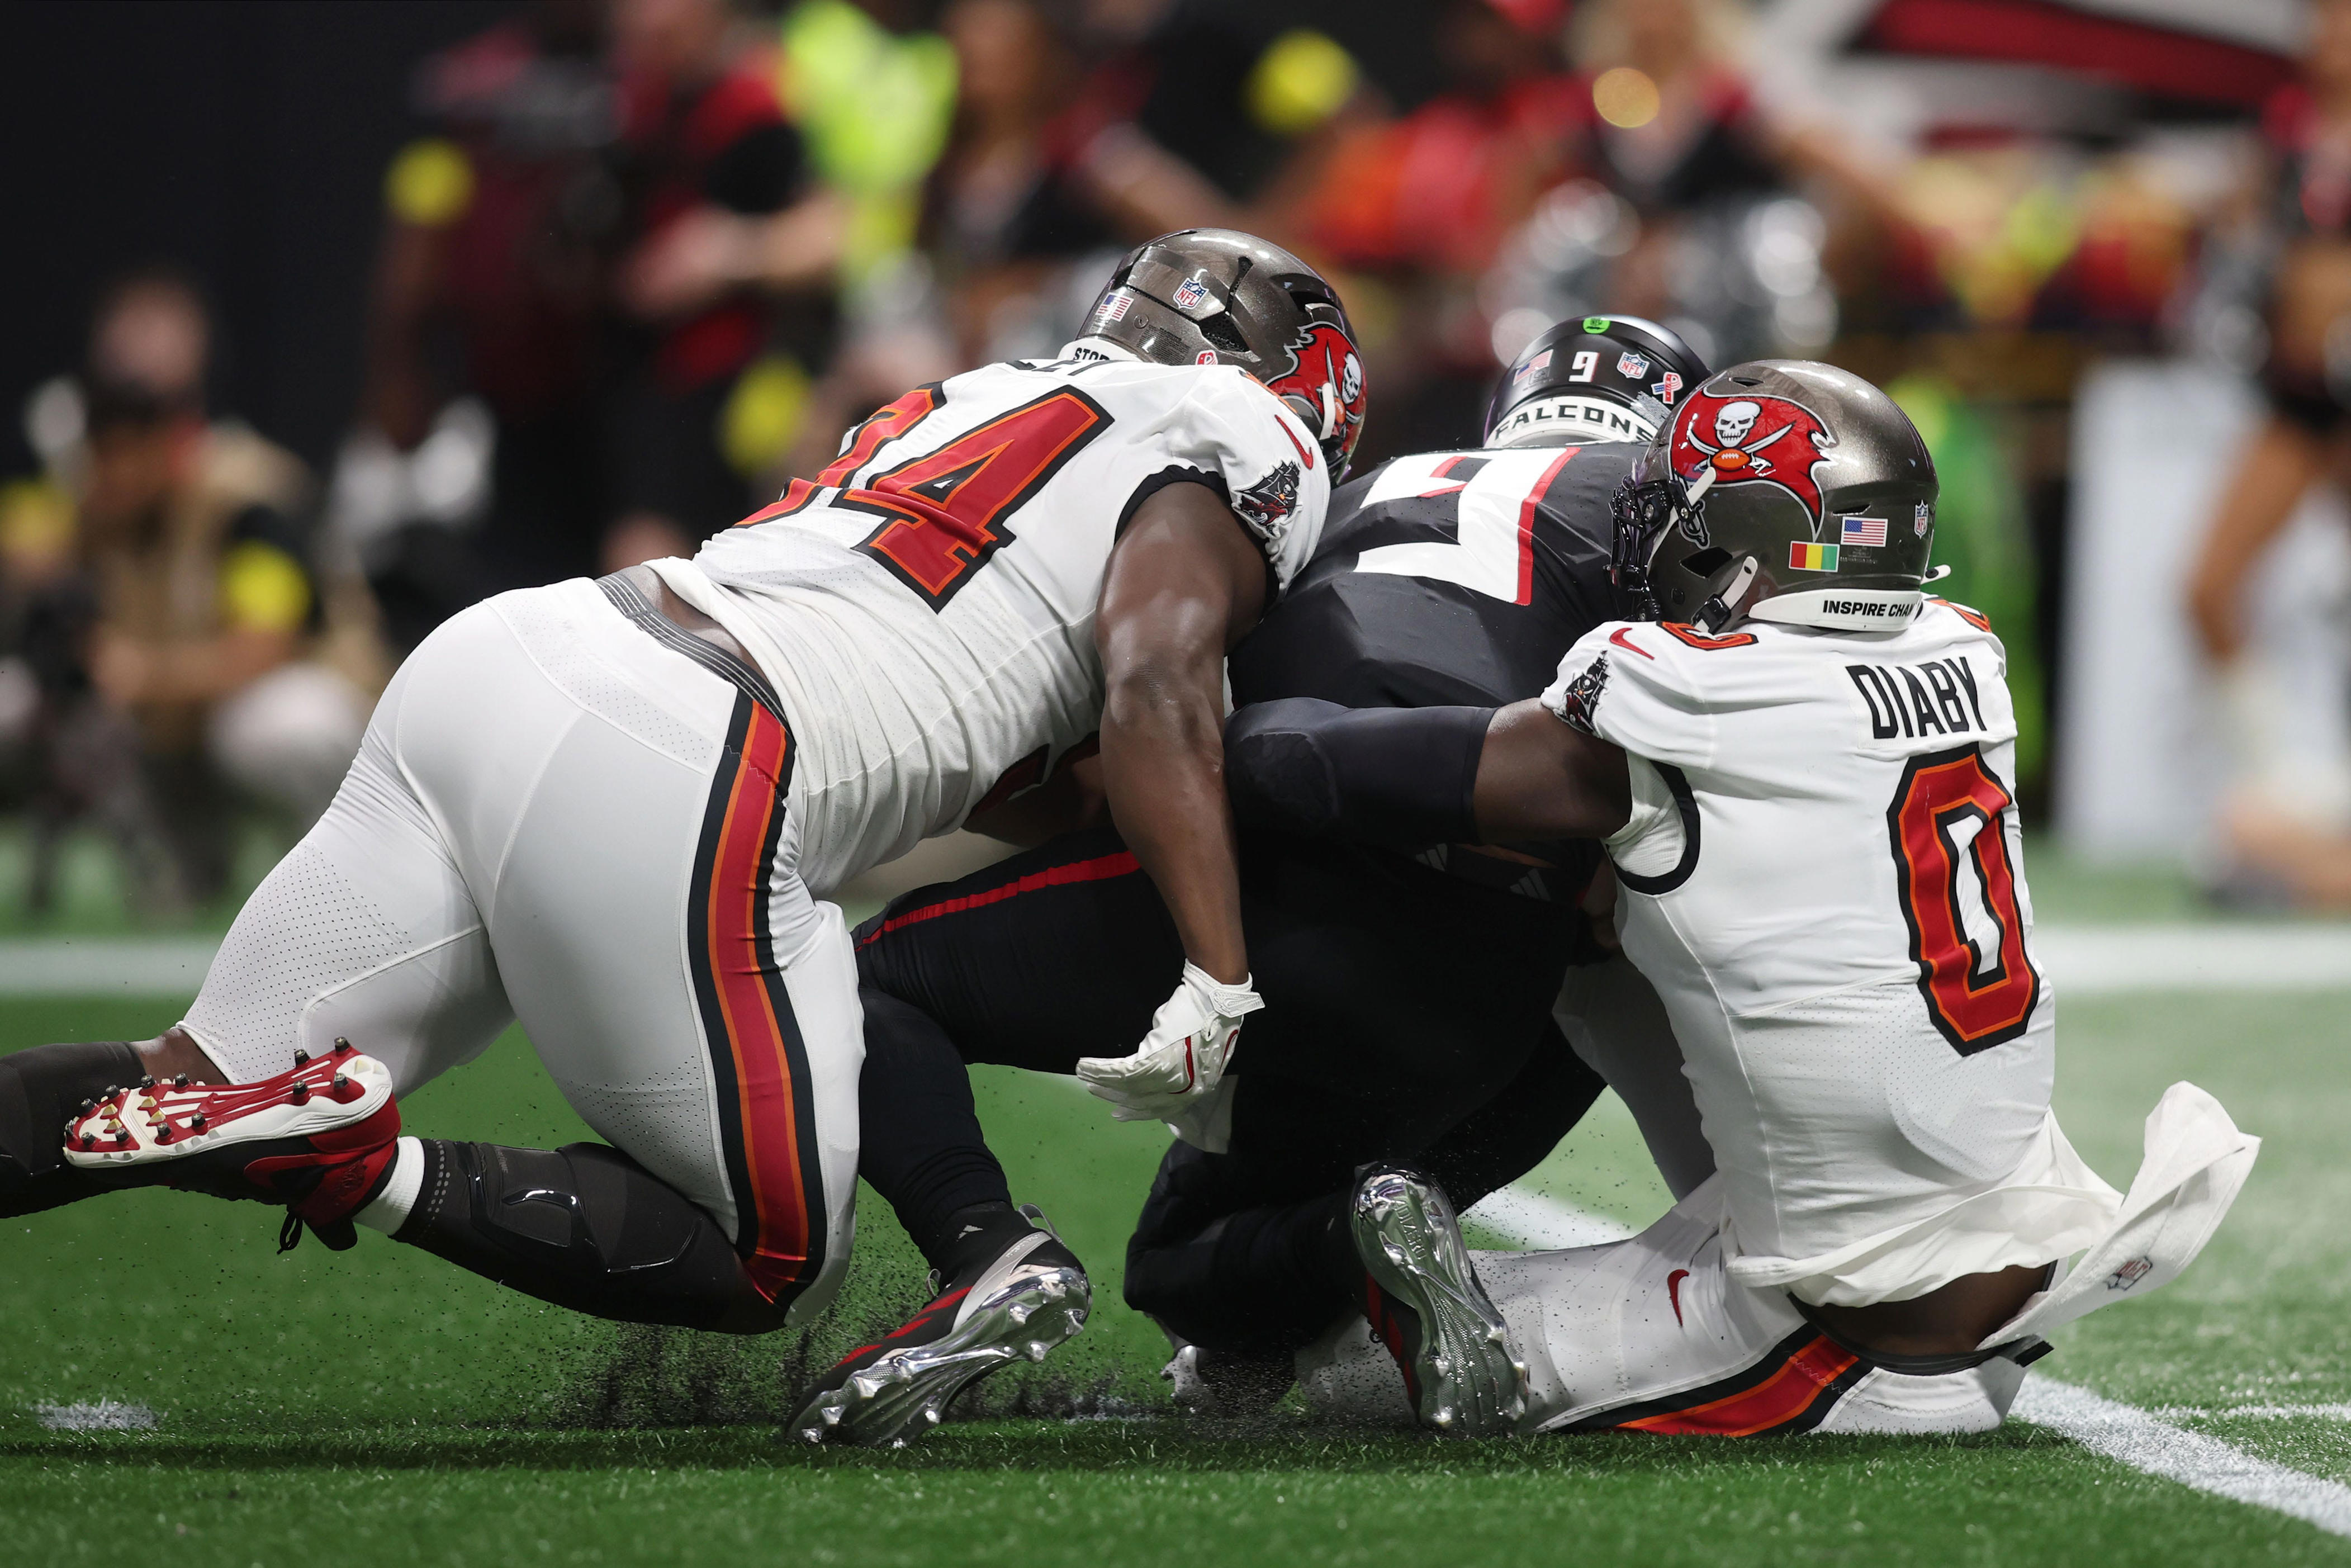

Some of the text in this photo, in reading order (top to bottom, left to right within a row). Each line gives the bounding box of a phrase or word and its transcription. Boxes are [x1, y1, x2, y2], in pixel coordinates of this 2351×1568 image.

[1177, 289, 1197, 305] NFL
[1568, 351, 1600, 382] 9
[1622, 362, 1640, 376] NFL
[1353, 447, 1581, 605] 9
[1917, 518, 1926, 530] NFL
[1823, 600, 1887, 617] INSPIRE
[1845, 656, 1987, 739] DIABY
[1887, 742, 2039, 1057] 0
